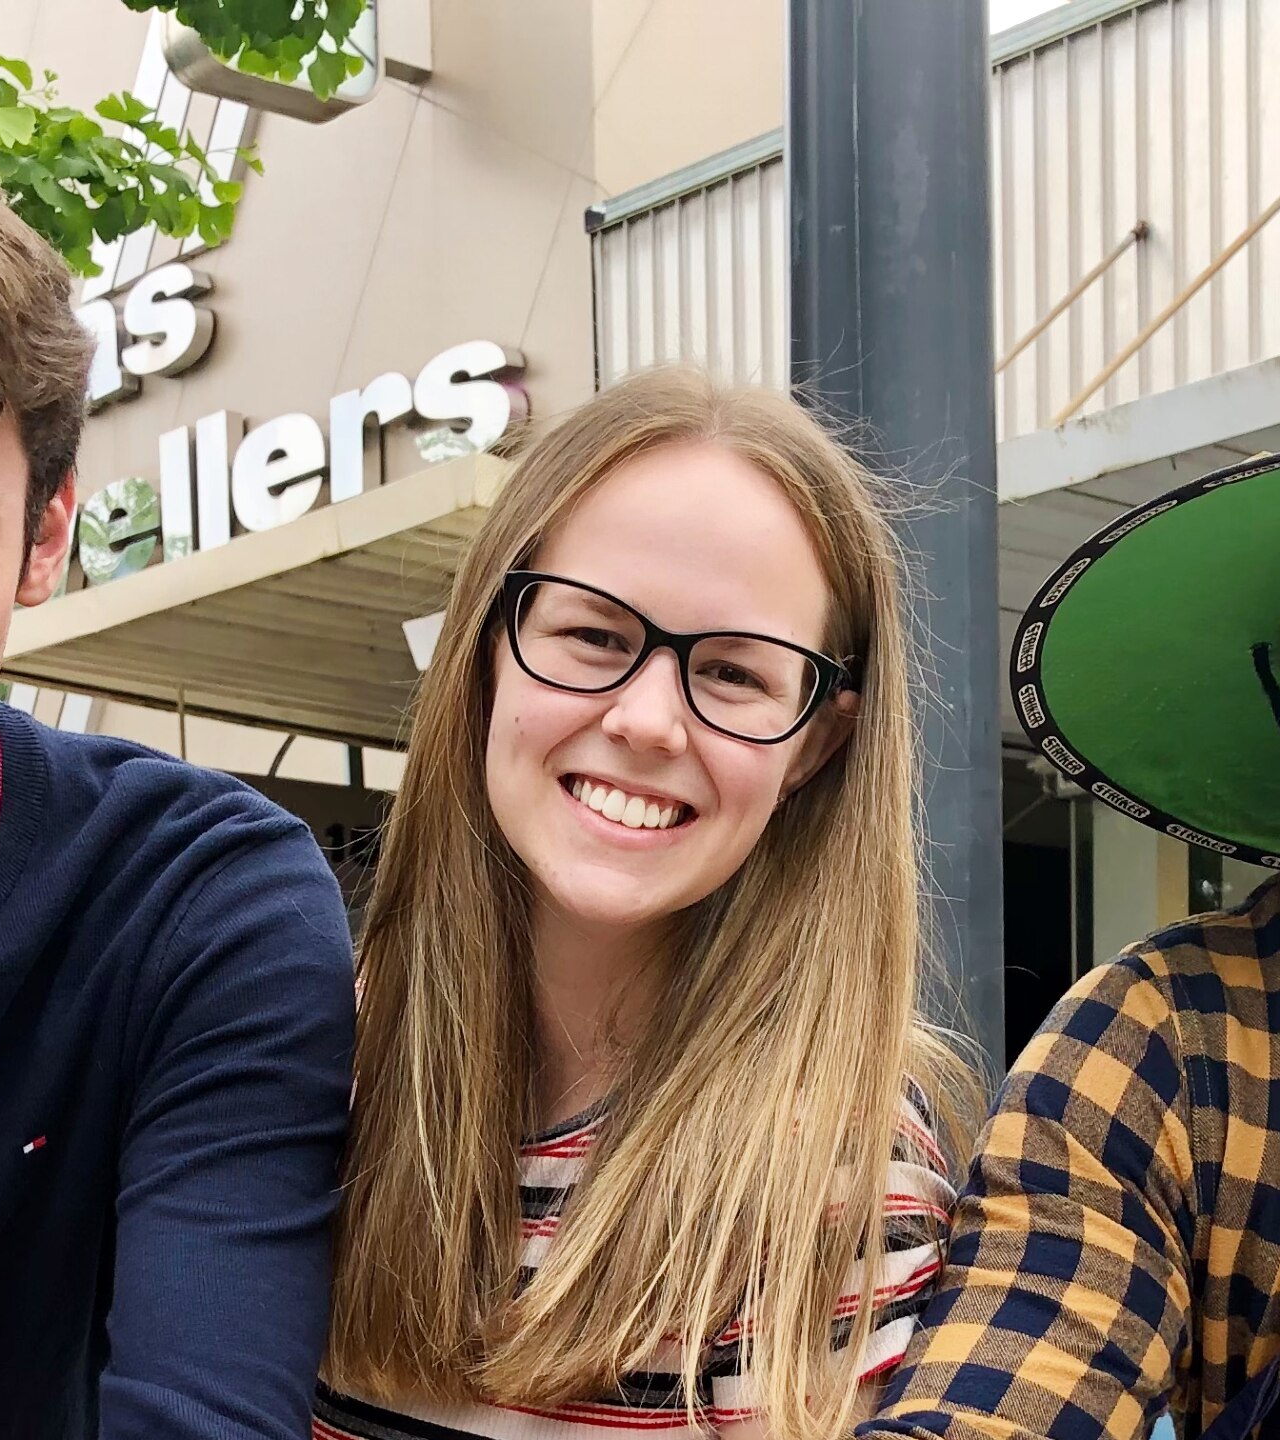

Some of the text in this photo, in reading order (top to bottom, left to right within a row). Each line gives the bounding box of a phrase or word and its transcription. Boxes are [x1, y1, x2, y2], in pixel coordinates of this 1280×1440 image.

[60, 339, 512, 587] ellers
[1019, 623, 1041, 671] STRIKER
[1020, 685, 1044, 727] STRIKER
[1044, 736, 1084, 774] STRIKER
[1093, 783, 1148, 818] STRIKER
[1167, 824, 1235, 854] STRIKER
